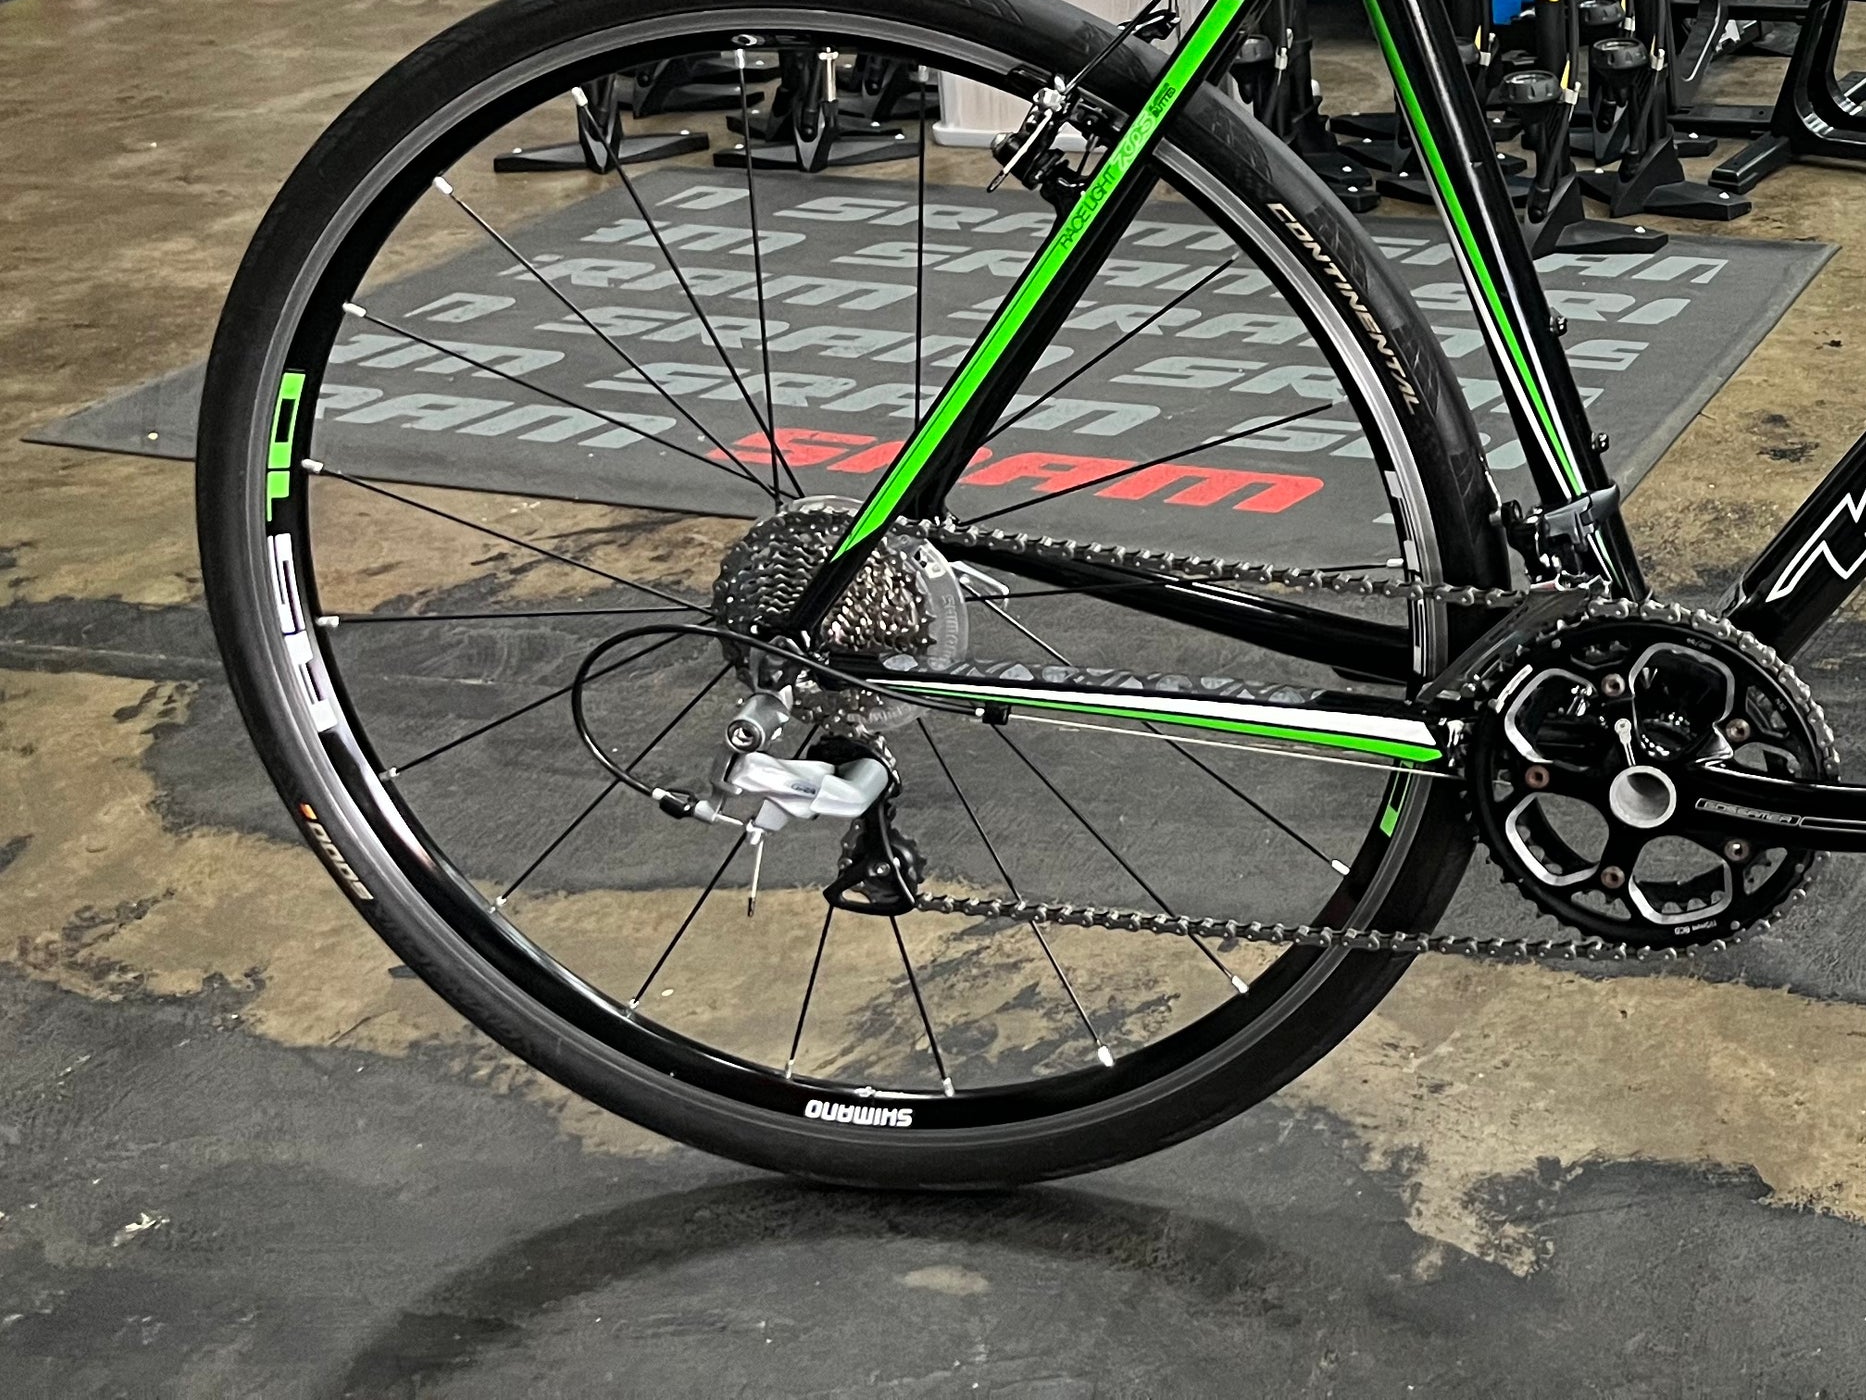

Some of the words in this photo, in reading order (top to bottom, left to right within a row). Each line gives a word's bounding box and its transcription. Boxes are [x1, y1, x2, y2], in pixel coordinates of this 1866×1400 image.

[1111, 111, 1157, 172] 7005
[1267, 201, 1421, 416] CONTINENTAL
[803, 1099, 914, 1128] SHIMANO
